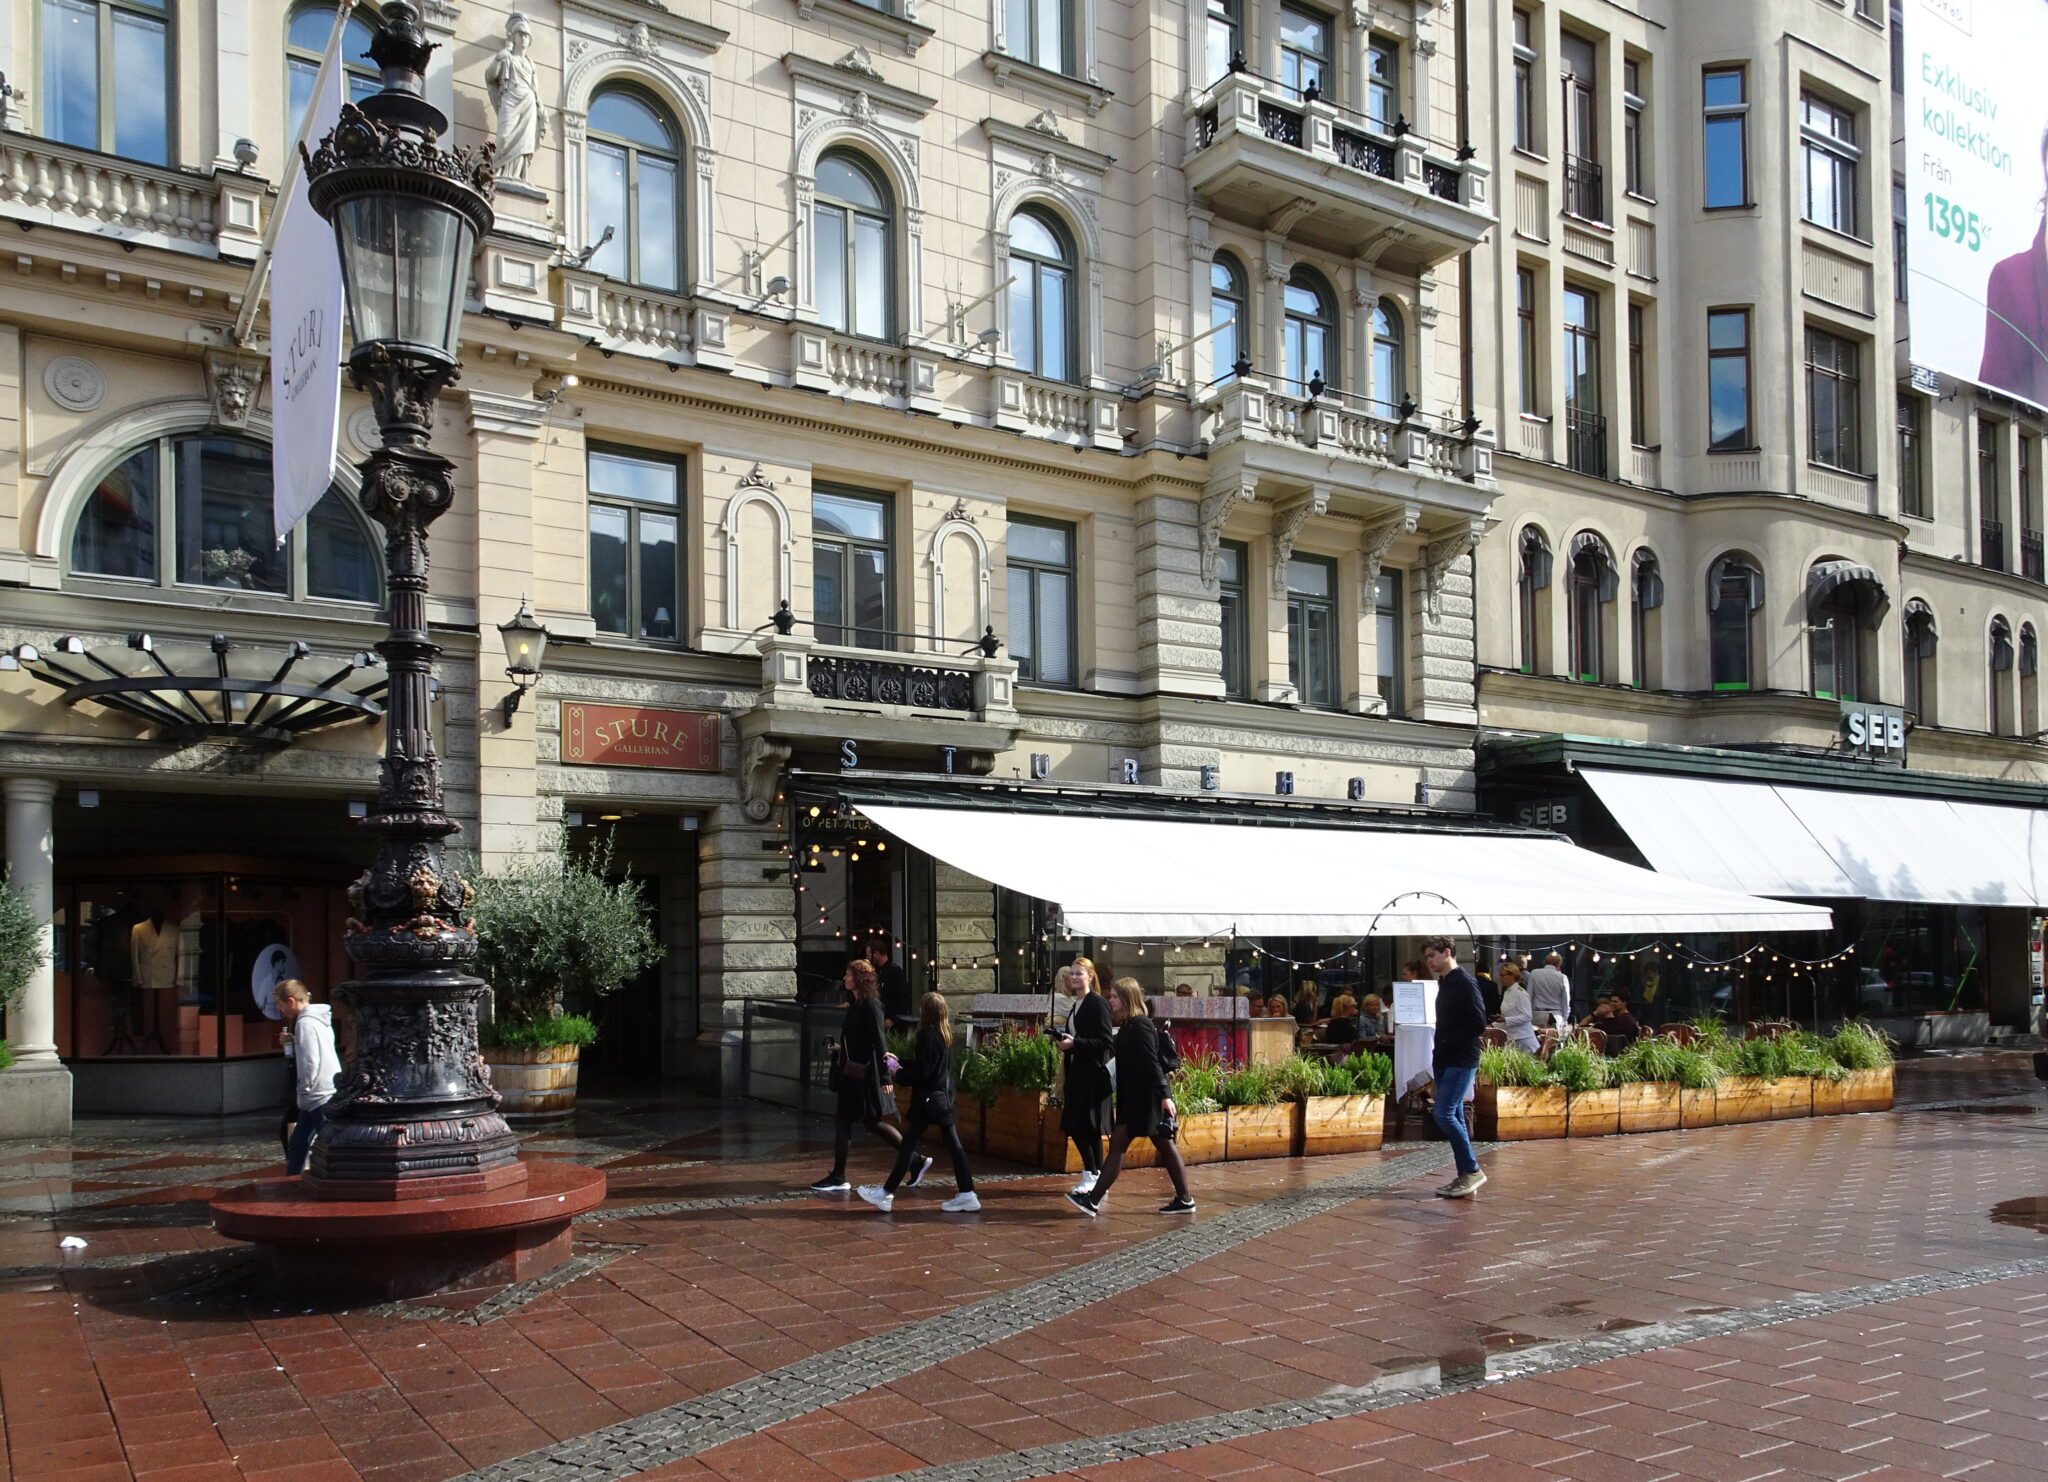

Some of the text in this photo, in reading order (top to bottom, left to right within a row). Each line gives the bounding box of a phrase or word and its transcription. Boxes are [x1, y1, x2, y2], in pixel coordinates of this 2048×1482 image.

[1922, 52, 1998, 121] Exklusiv
[1922, 96, 2012, 177] kollektion
[1923, 153, 1952, 185] Från
[1924, 192, 1981, 252] 1395
[595, 718, 688, 751] STURE
[1848, 712, 1904, 748] SEB
[614, 744, 669, 755] GALLERIAN
[844, 819, 872, 831] ALLA
[1519, 805, 1567, 826] SEB
[740, 922, 777, 936] STURE
[947, 923, 979, 936] STURE
